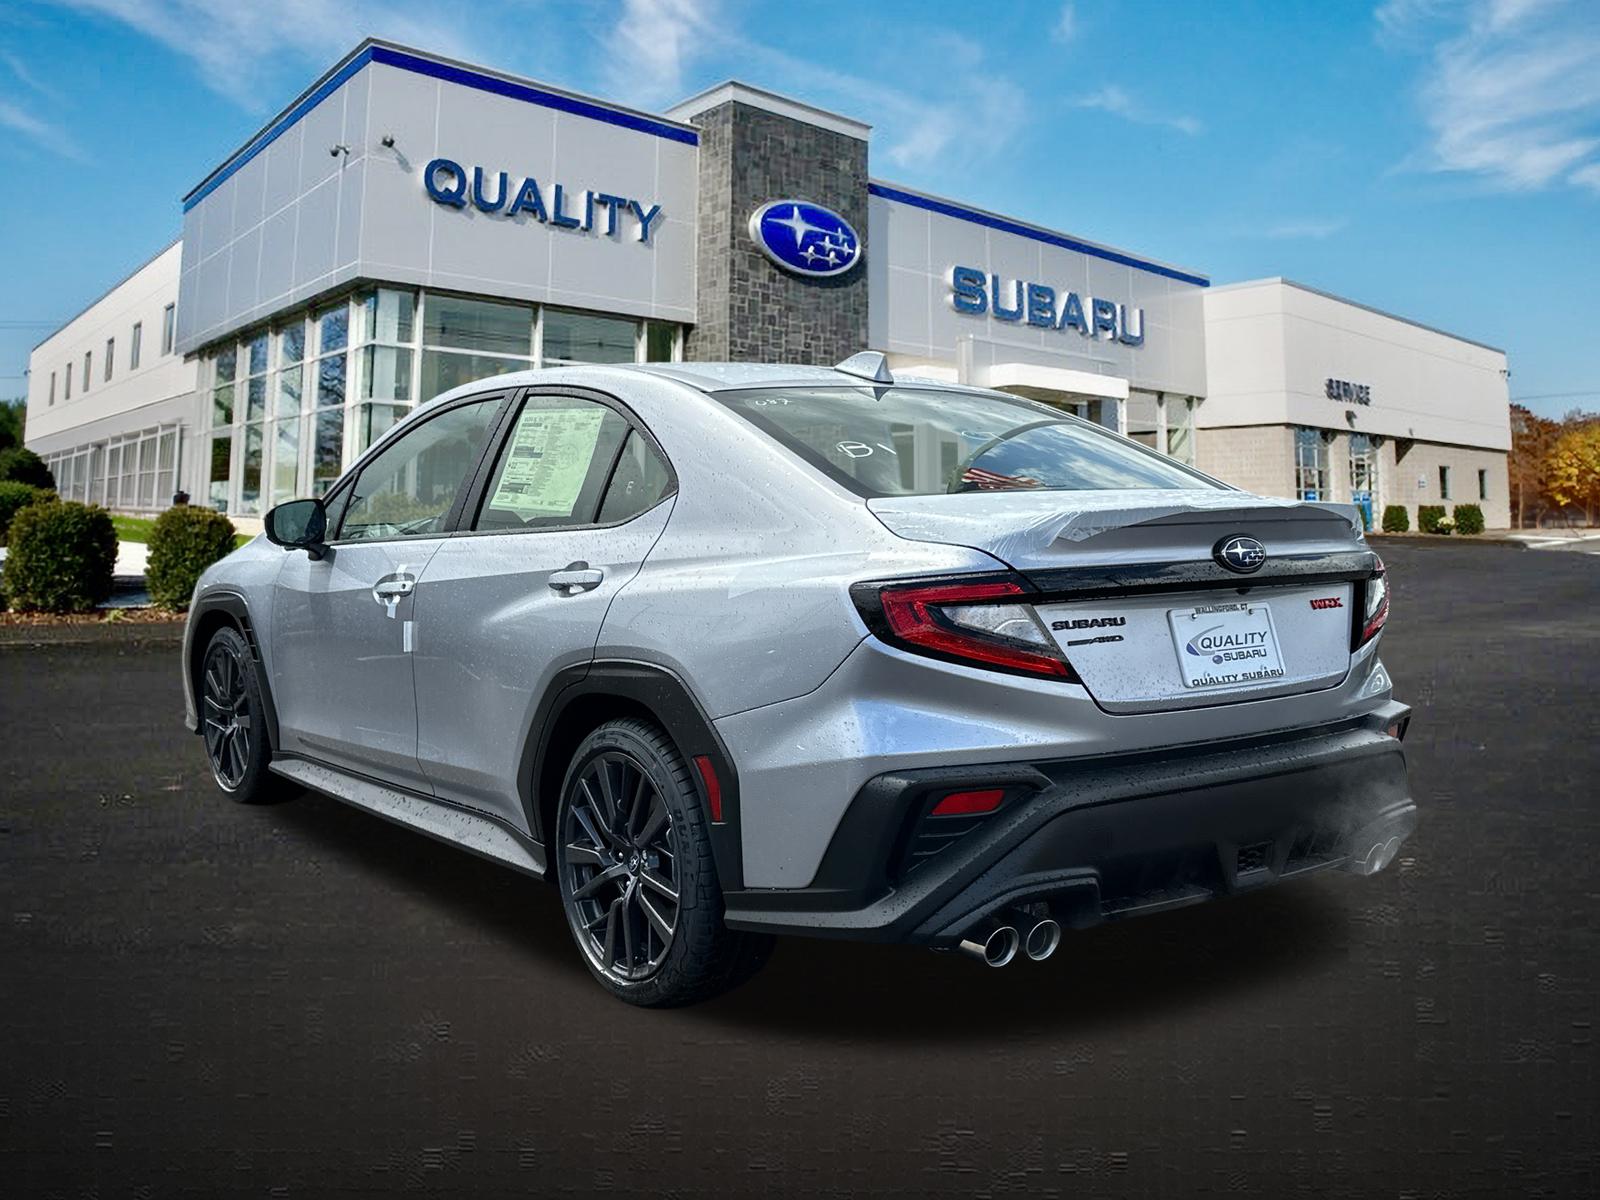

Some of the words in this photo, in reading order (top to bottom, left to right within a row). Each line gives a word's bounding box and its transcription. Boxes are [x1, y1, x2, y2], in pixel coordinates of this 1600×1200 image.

[423, 158, 662, 243] QUALITY
[950, 265, 1145, 347] SUBARU
[1325, 378, 1371, 406] SERVICE
[1309, 597, 1344, 610] WRX
[1051, 616, 1127, 631] SUBARU
[1200, 631, 1268, 649] QUALITY
[1222, 648, 1267, 662] SUBARU
[1191, 673, 1239, 687] QUALITY
[1241, 668, 1285, 681] SUBARU
